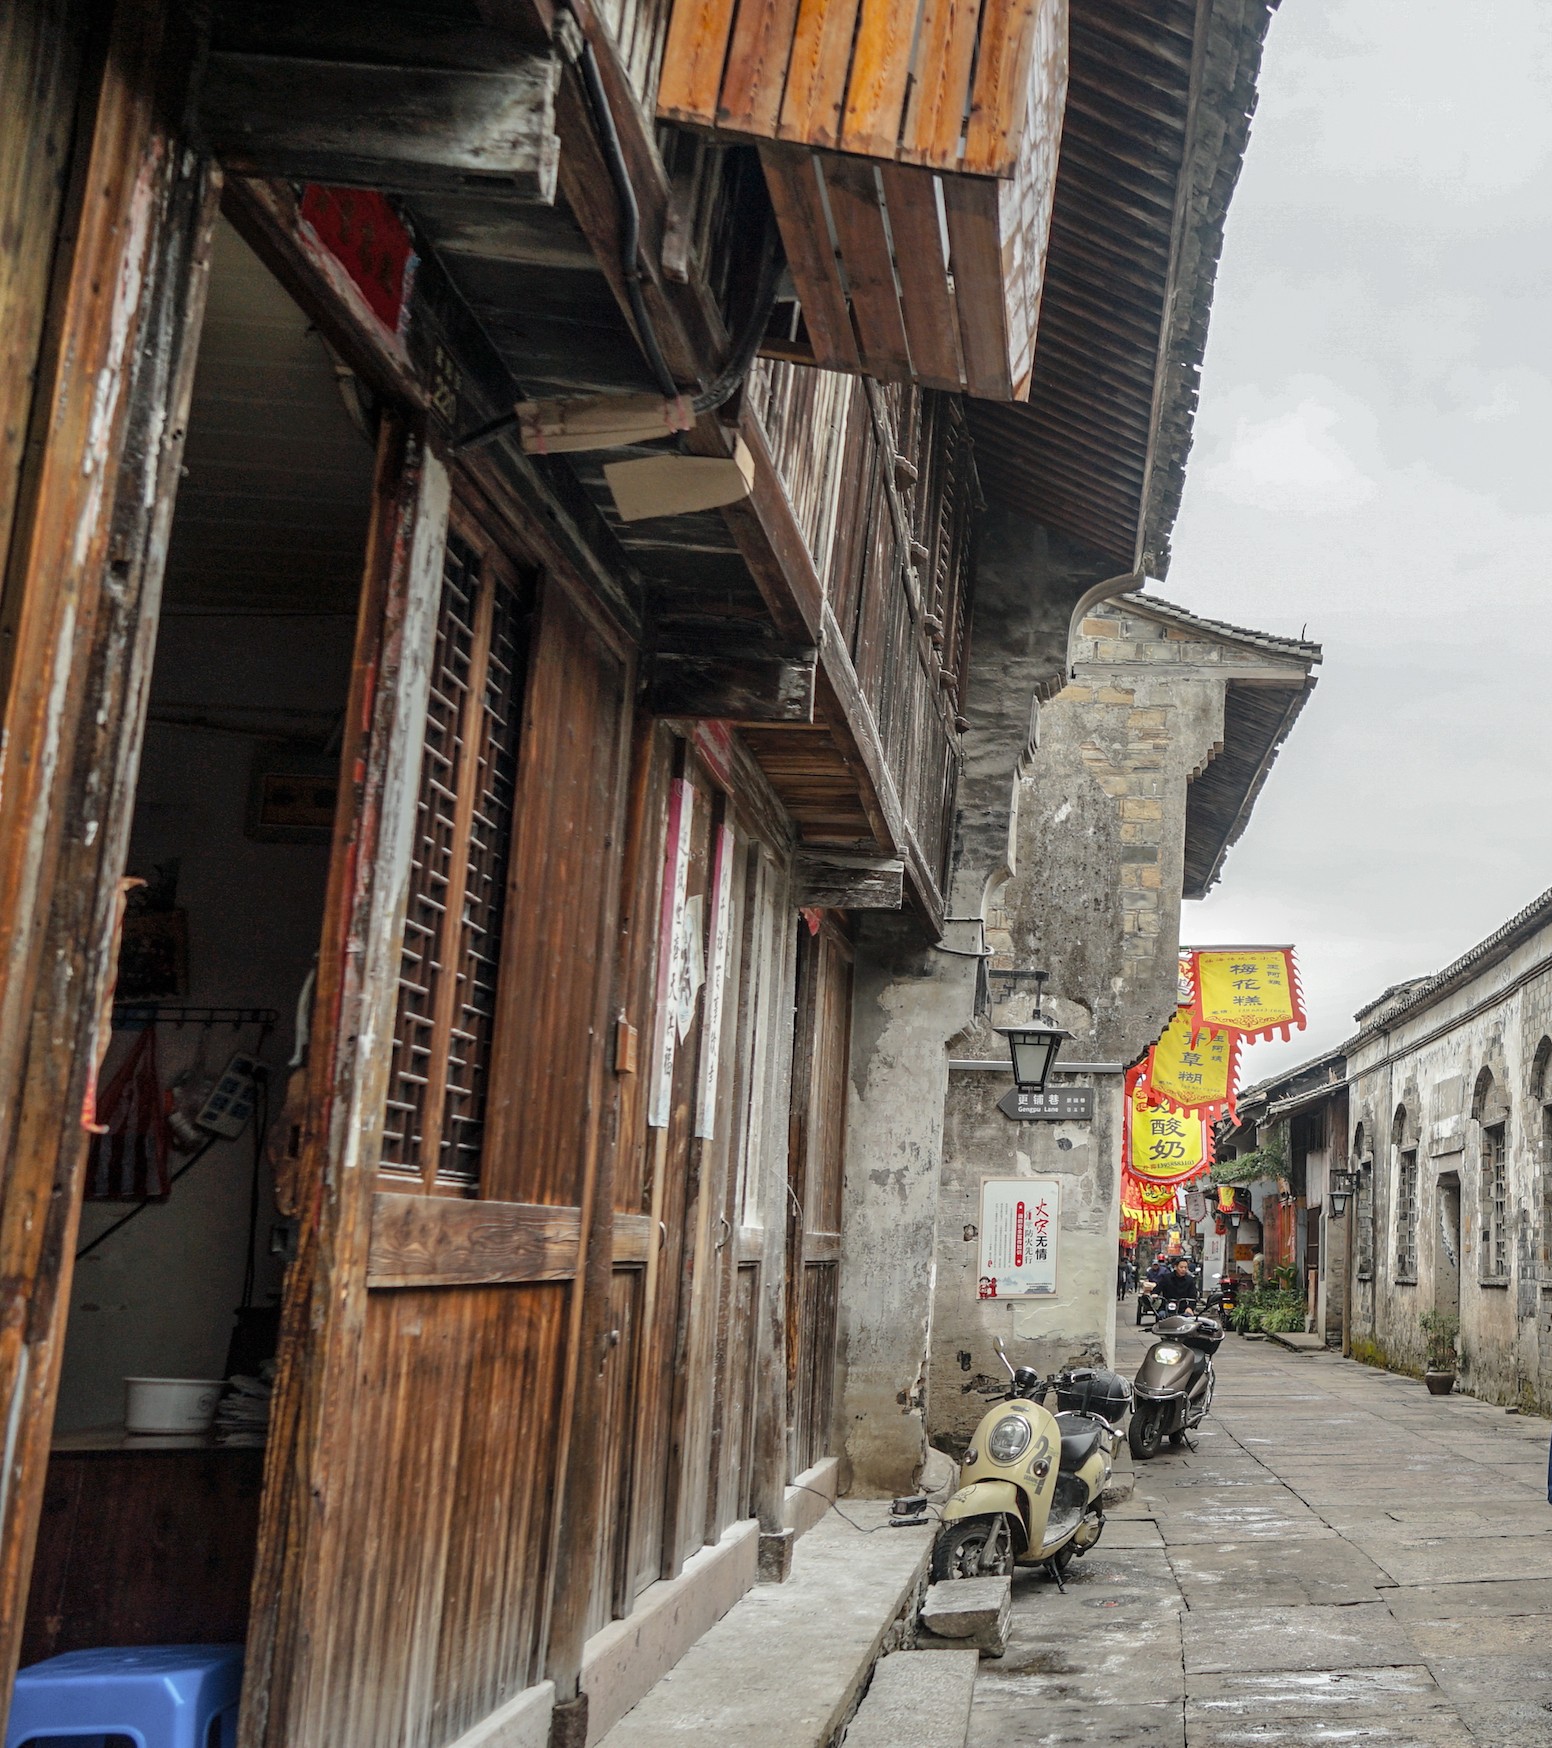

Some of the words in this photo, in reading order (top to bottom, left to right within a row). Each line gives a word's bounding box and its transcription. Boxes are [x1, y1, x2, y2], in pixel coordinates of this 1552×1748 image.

[1229, 963, 1264, 1007] 梅花糕
[1178, 1031, 1207, 1085] 青草糊
[1035, 1198, 1049, 1260] 火灾无情
